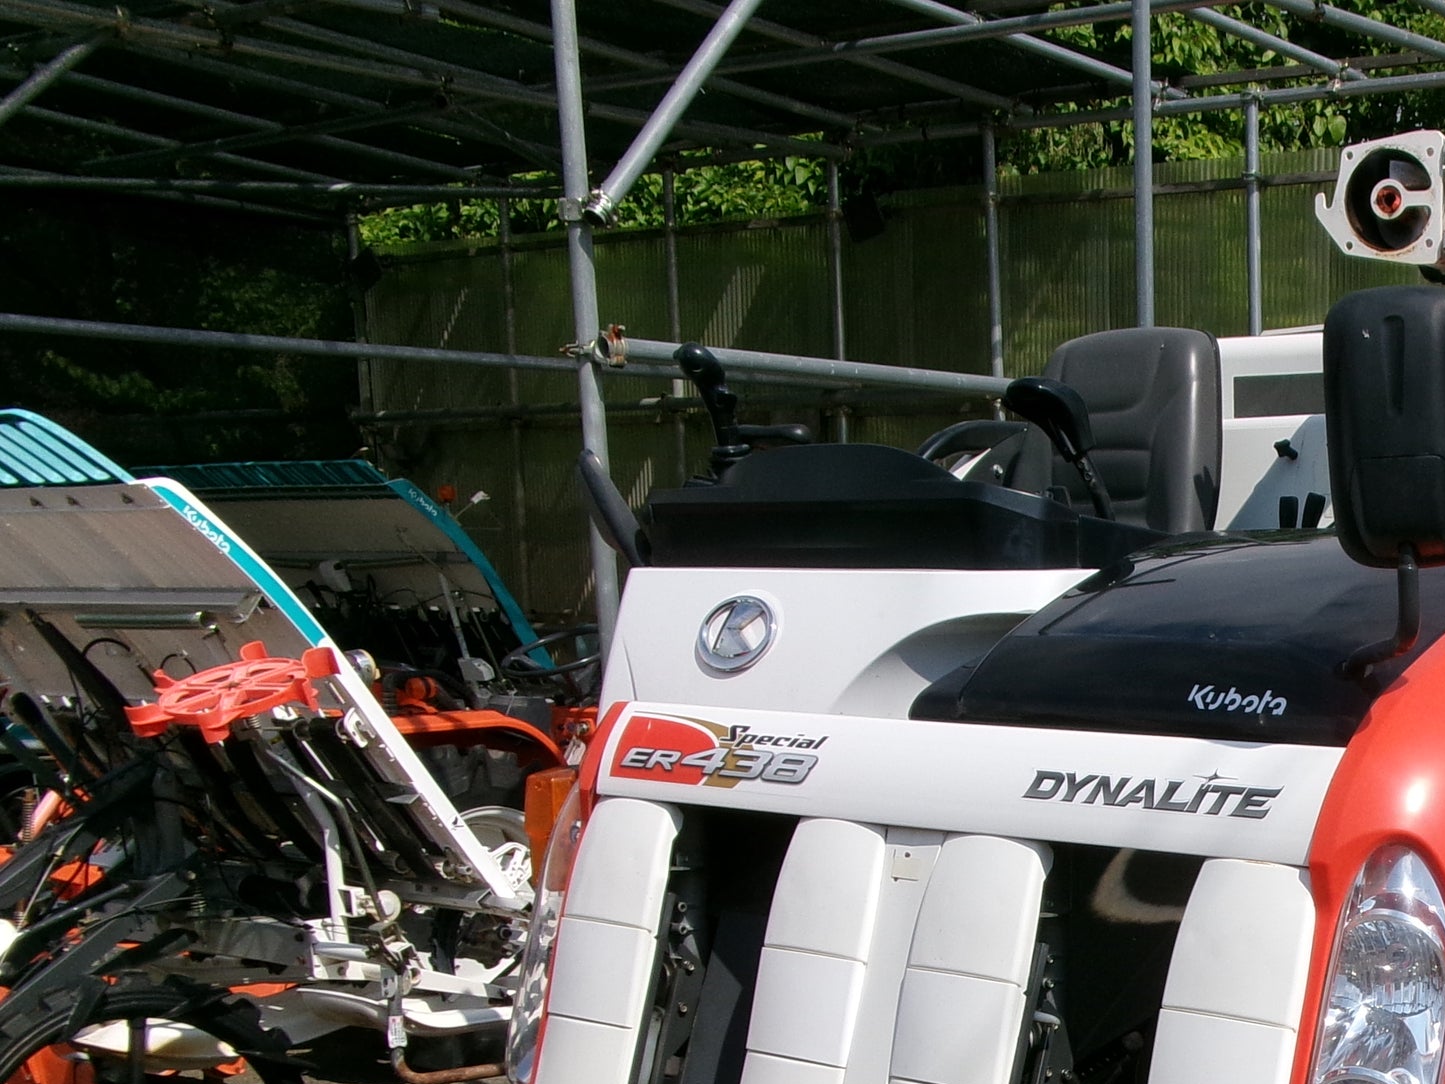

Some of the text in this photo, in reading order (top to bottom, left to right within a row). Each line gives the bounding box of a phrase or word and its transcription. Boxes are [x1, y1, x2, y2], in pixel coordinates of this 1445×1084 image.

[408, 488, 438, 517] Kubota
[182, 504, 231, 554] Kubota
[1187, 684, 1288, 716] Kubota
[719, 725, 829, 751] Special
[1021, 768, 1285, 820] DYNALITE
